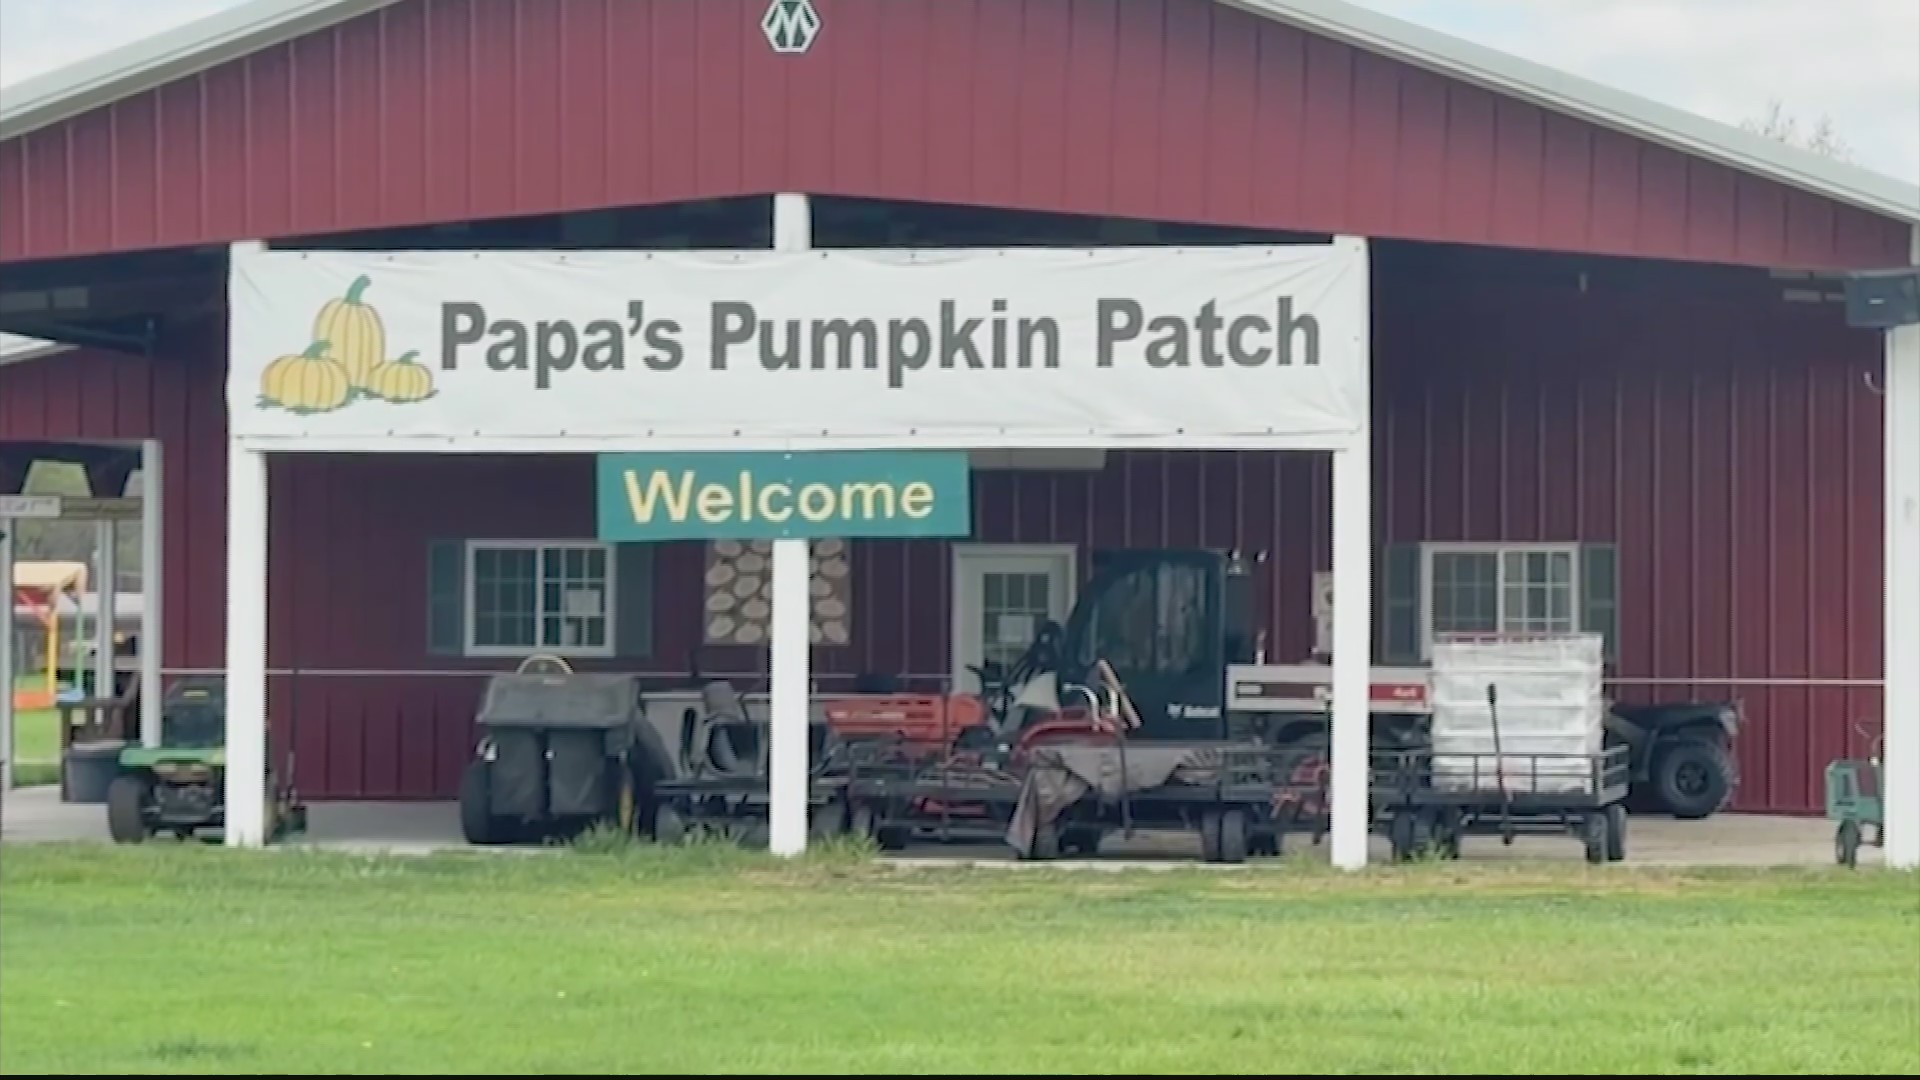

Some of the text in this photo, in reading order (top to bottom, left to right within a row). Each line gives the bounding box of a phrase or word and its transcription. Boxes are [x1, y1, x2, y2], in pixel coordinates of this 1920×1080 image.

[440, 296, 1321, 390] Papa's Pumpkin Patch
[623, 470, 935, 524] Welcome
